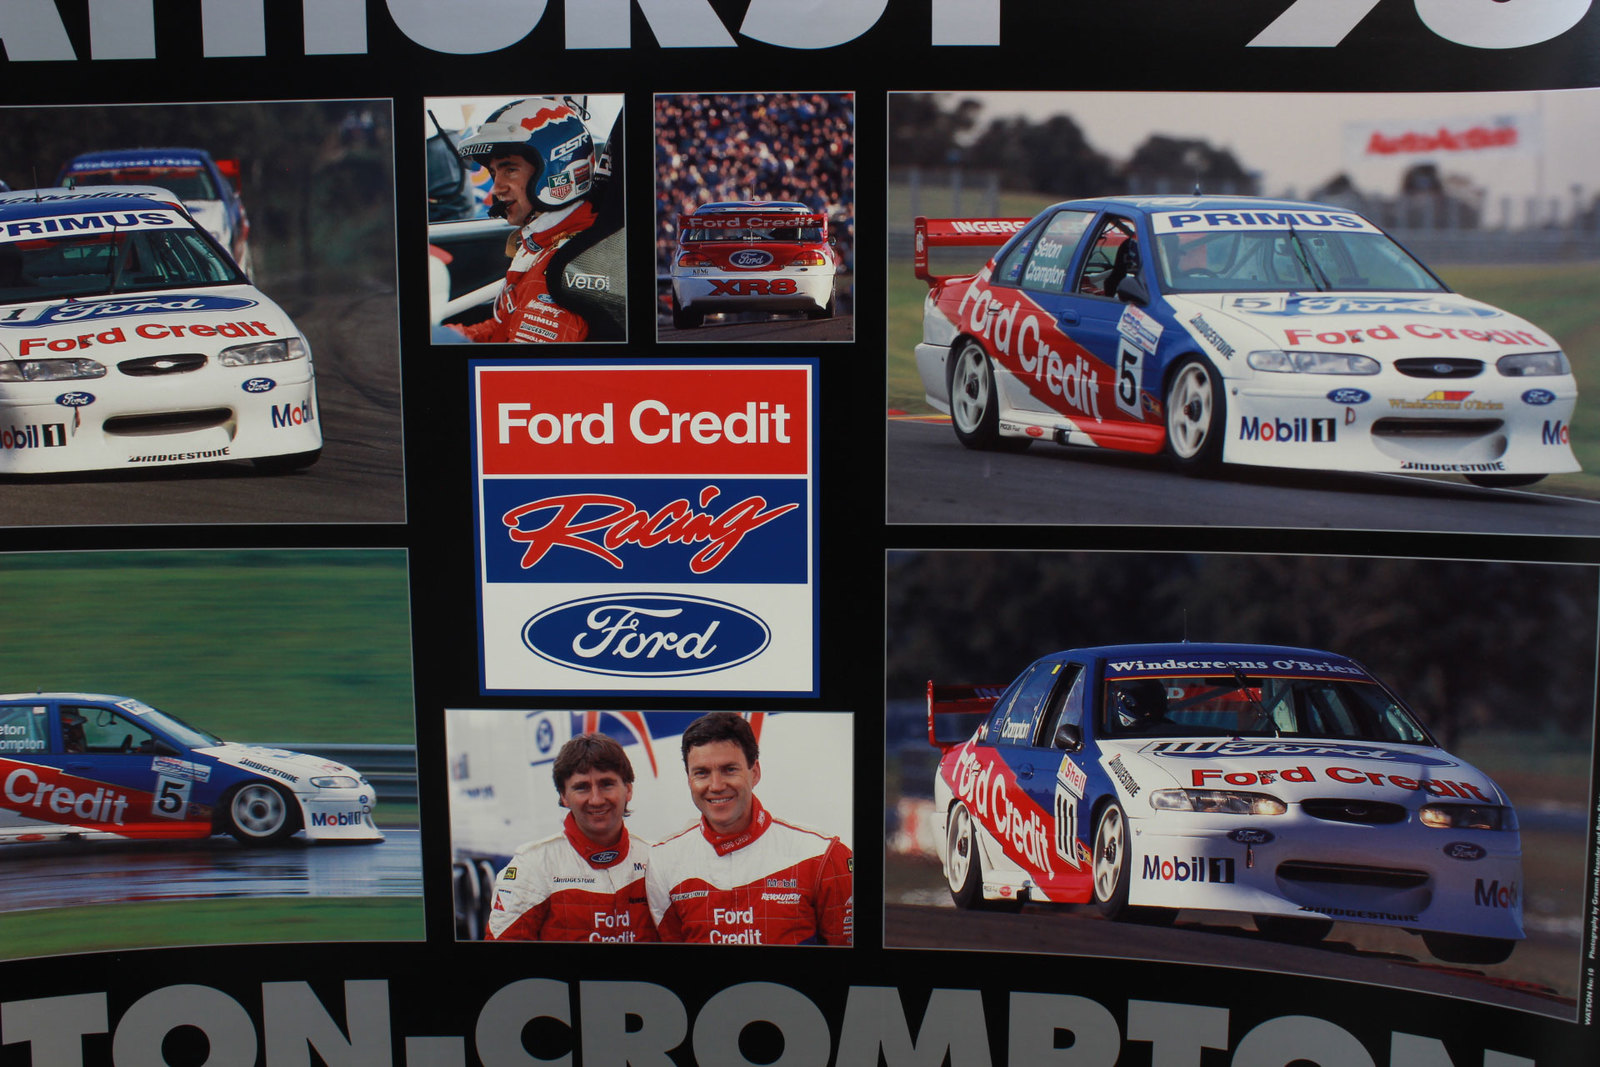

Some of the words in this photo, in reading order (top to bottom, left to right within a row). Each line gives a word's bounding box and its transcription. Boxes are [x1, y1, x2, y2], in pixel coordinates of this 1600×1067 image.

[0, 212, 174, 237] RIMUS
[689, 217, 740, 228] Ford
[750, 217, 814, 228] Credit
[1168, 212, 1364, 229] PRIMUS
[738, 252, 764, 265] Ford
[1034, 236, 1063, 258] Seton
[1024, 260, 1066, 288] Crompton
[707, 278, 798, 297] XR8
[523, 313, 559, 328] PRIMUS
[19, 327, 127, 356] Ford
[135, 320, 277, 341] Credit
[958, 265, 1021, 356] Ford
[1017, 315, 1103, 424] Credit
[1284, 325, 1400, 346] Ford
[1404, 324, 1549, 347] Credit
[1119, 349, 1138, 407] 5
[498, 403, 614, 445] Ford
[629, 399, 791, 444] Credit
[1239, 416, 1307, 442] Mobil
[1314, 418, 1334, 442] 1
[0, 424, 39, 449] obil
[45, 424, 63, 447] 1
[127, 447, 230, 463] BRIDGESTONE
[502, 486, 800, 574] Racing
[572, 605, 721, 659] Ford
[1109, 660, 1269, 673] Windscreens
[1272, 660, 1365, 676] O'Brien
[1002, 716, 1031, 744] Crompton
[238, 758, 299, 783] BRIDGESTONE
[1064, 767, 1085, 792] Shell
[1191, 766, 1317, 787] Ford
[1325, 767, 1491, 802] Credit
[4, 768, 128, 826] Credit
[157, 781, 185, 813] 5
[312, 812, 353, 826] Mobil
[992, 774, 1055, 881] Credit
[1142, 855, 1205, 882] Mobil
[1212, 858, 1231, 883] 1
[766, 879, 797, 888] Mobil
[594, 910, 630, 928] Ford
[713, 907, 754, 925] Ford
[709, 929, 762, 945] Credit
[1588, 917, 1599, 960] Photography
[1584, 991, 1593, 1026] WATSON
